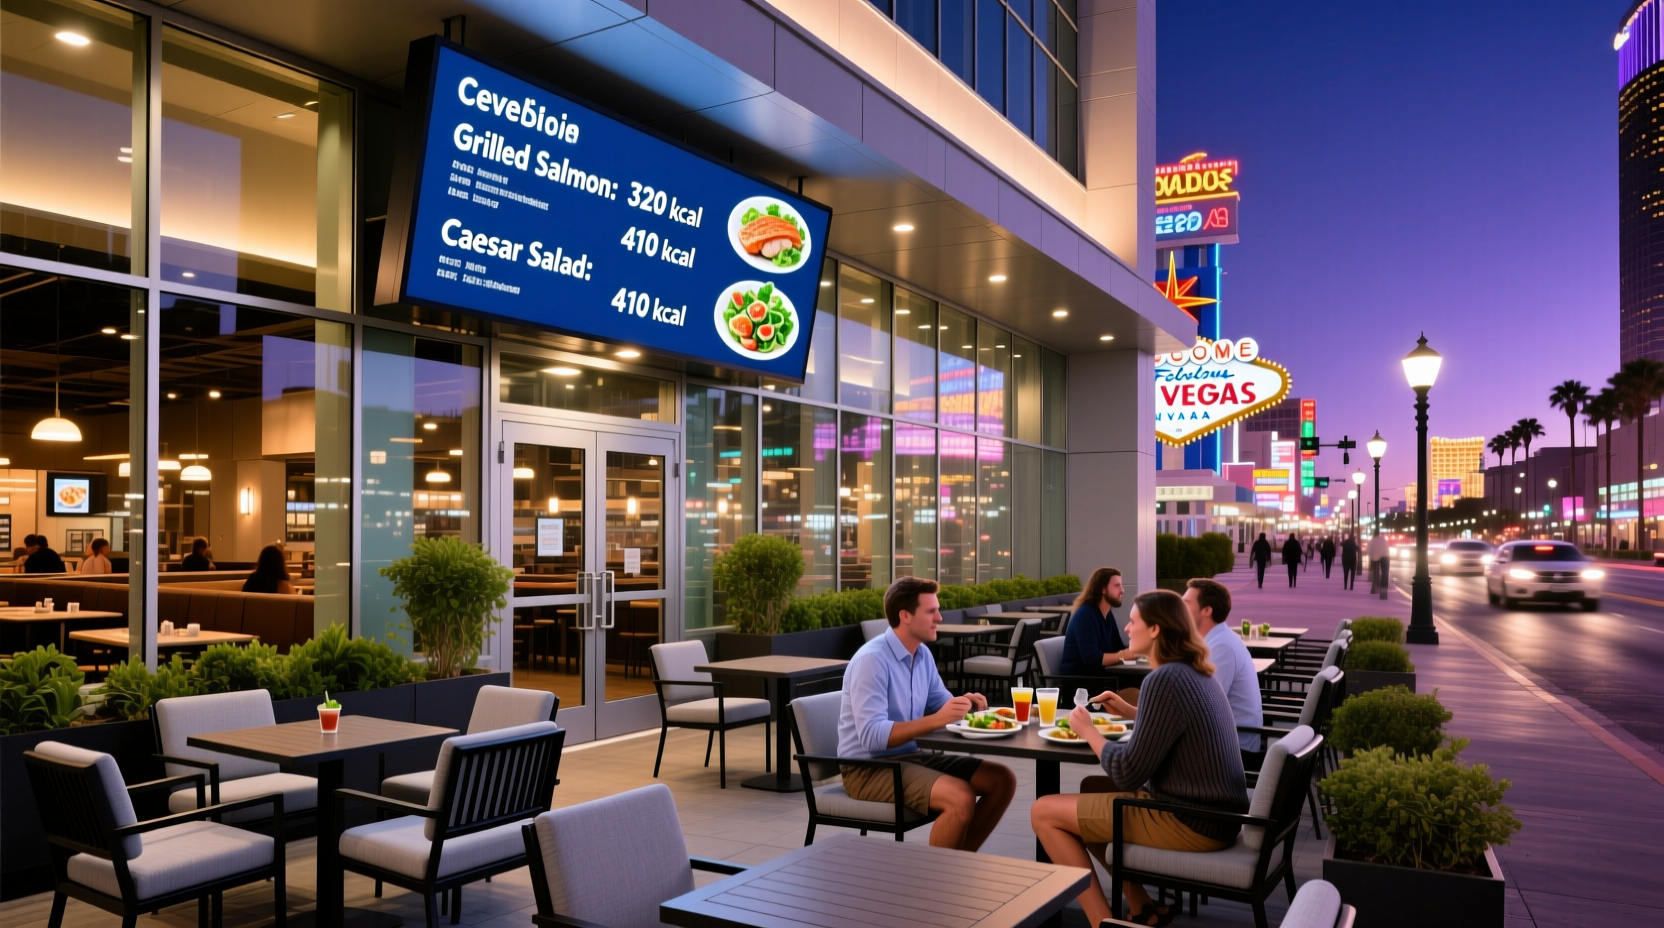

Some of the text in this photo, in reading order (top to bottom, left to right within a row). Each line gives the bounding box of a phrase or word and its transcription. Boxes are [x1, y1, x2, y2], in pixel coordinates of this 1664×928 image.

[453, 122, 531, 171] Grilled
[535, 150, 619, 201] Salmon:
[627, 181, 668, 216] 320
[668, 196, 704, 228] kcal
[441, 218, 524, 262] Caesar
[526, 241, 593, 281] Salad:
[620, 226, 696, 269] 410 kcal
[611, 287, 687, 327] 410 kcal
[1160, 382, 1256, 406] VEGAS
